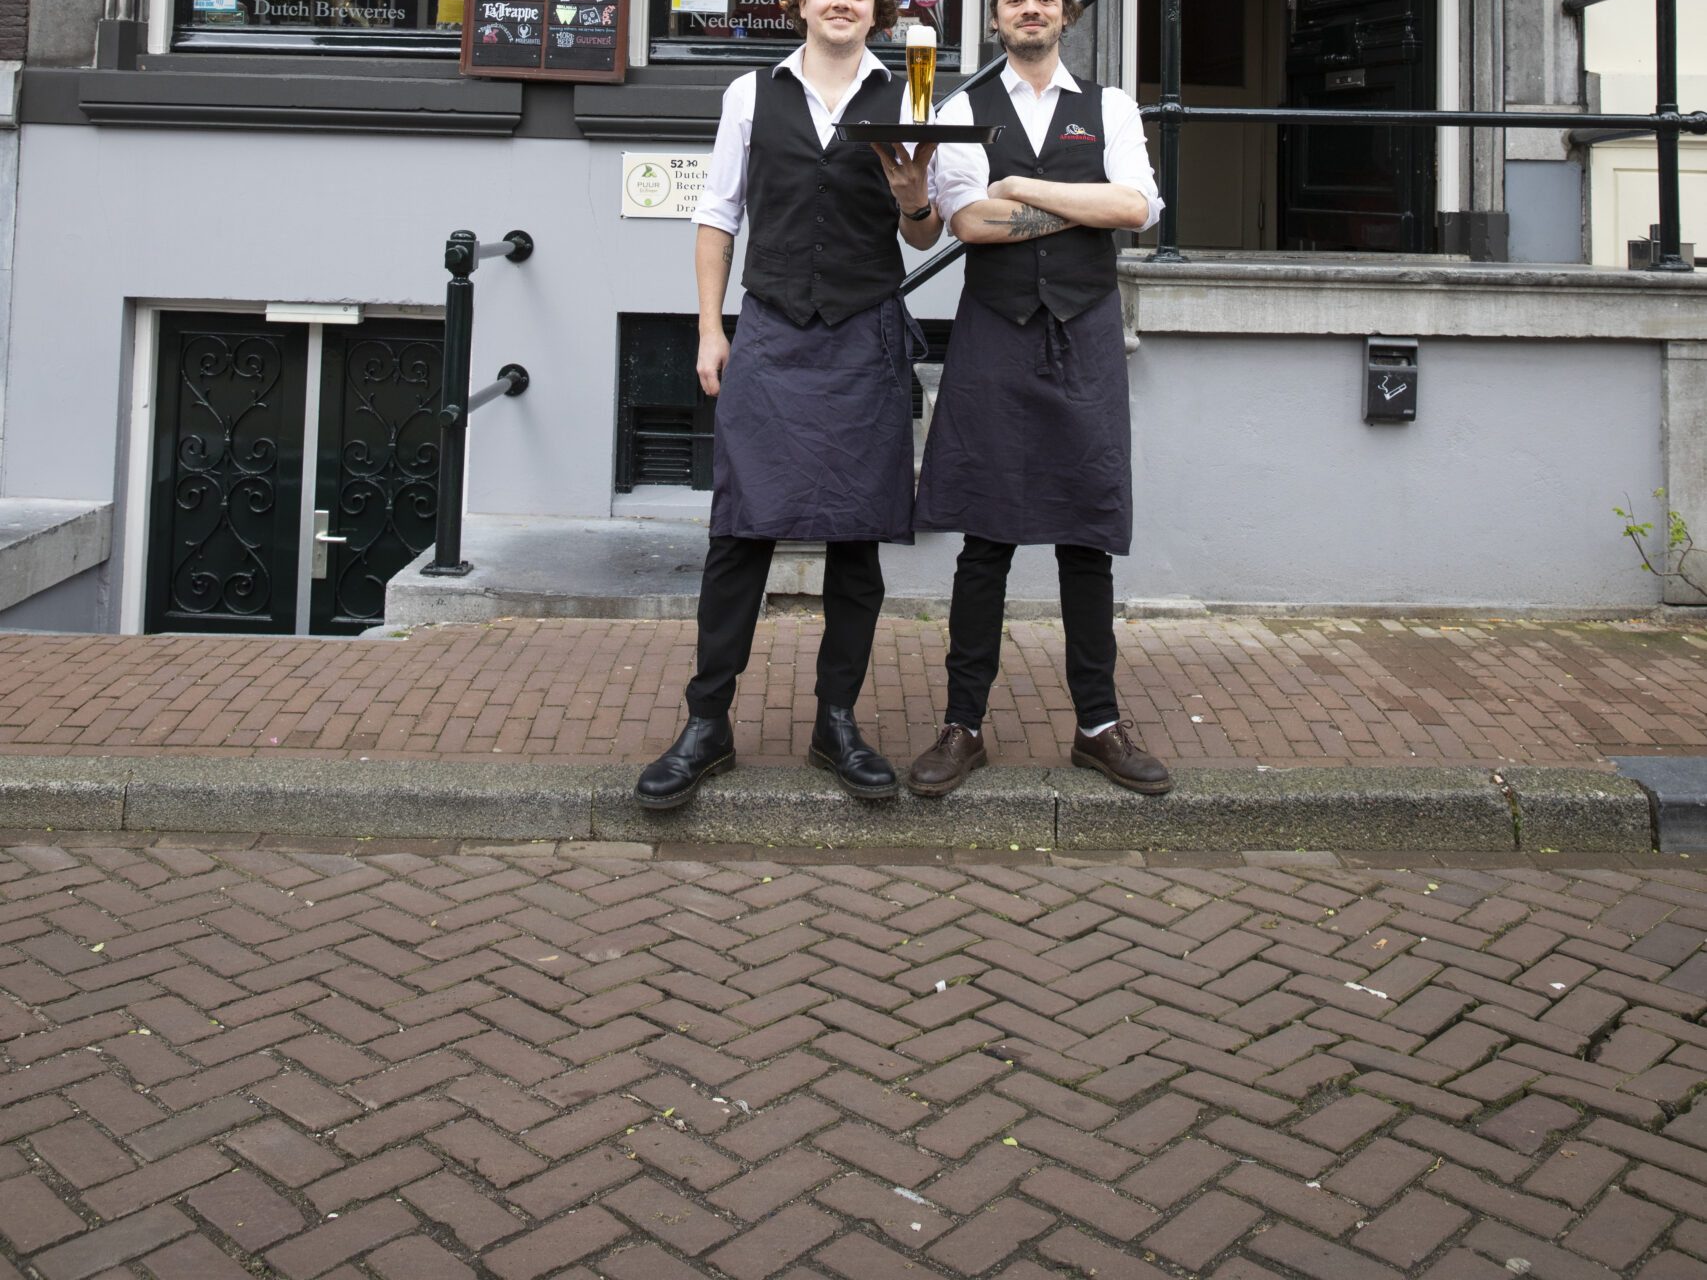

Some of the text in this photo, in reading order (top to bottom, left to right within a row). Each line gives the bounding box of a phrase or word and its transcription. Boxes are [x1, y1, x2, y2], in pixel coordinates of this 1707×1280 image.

[254, 0, 405, 19] Dutch Breweries
[495, 2, 539, 22] Trappe
[670, 159, 684, 169] 52
[675, 170, 708, 179] Dutch
